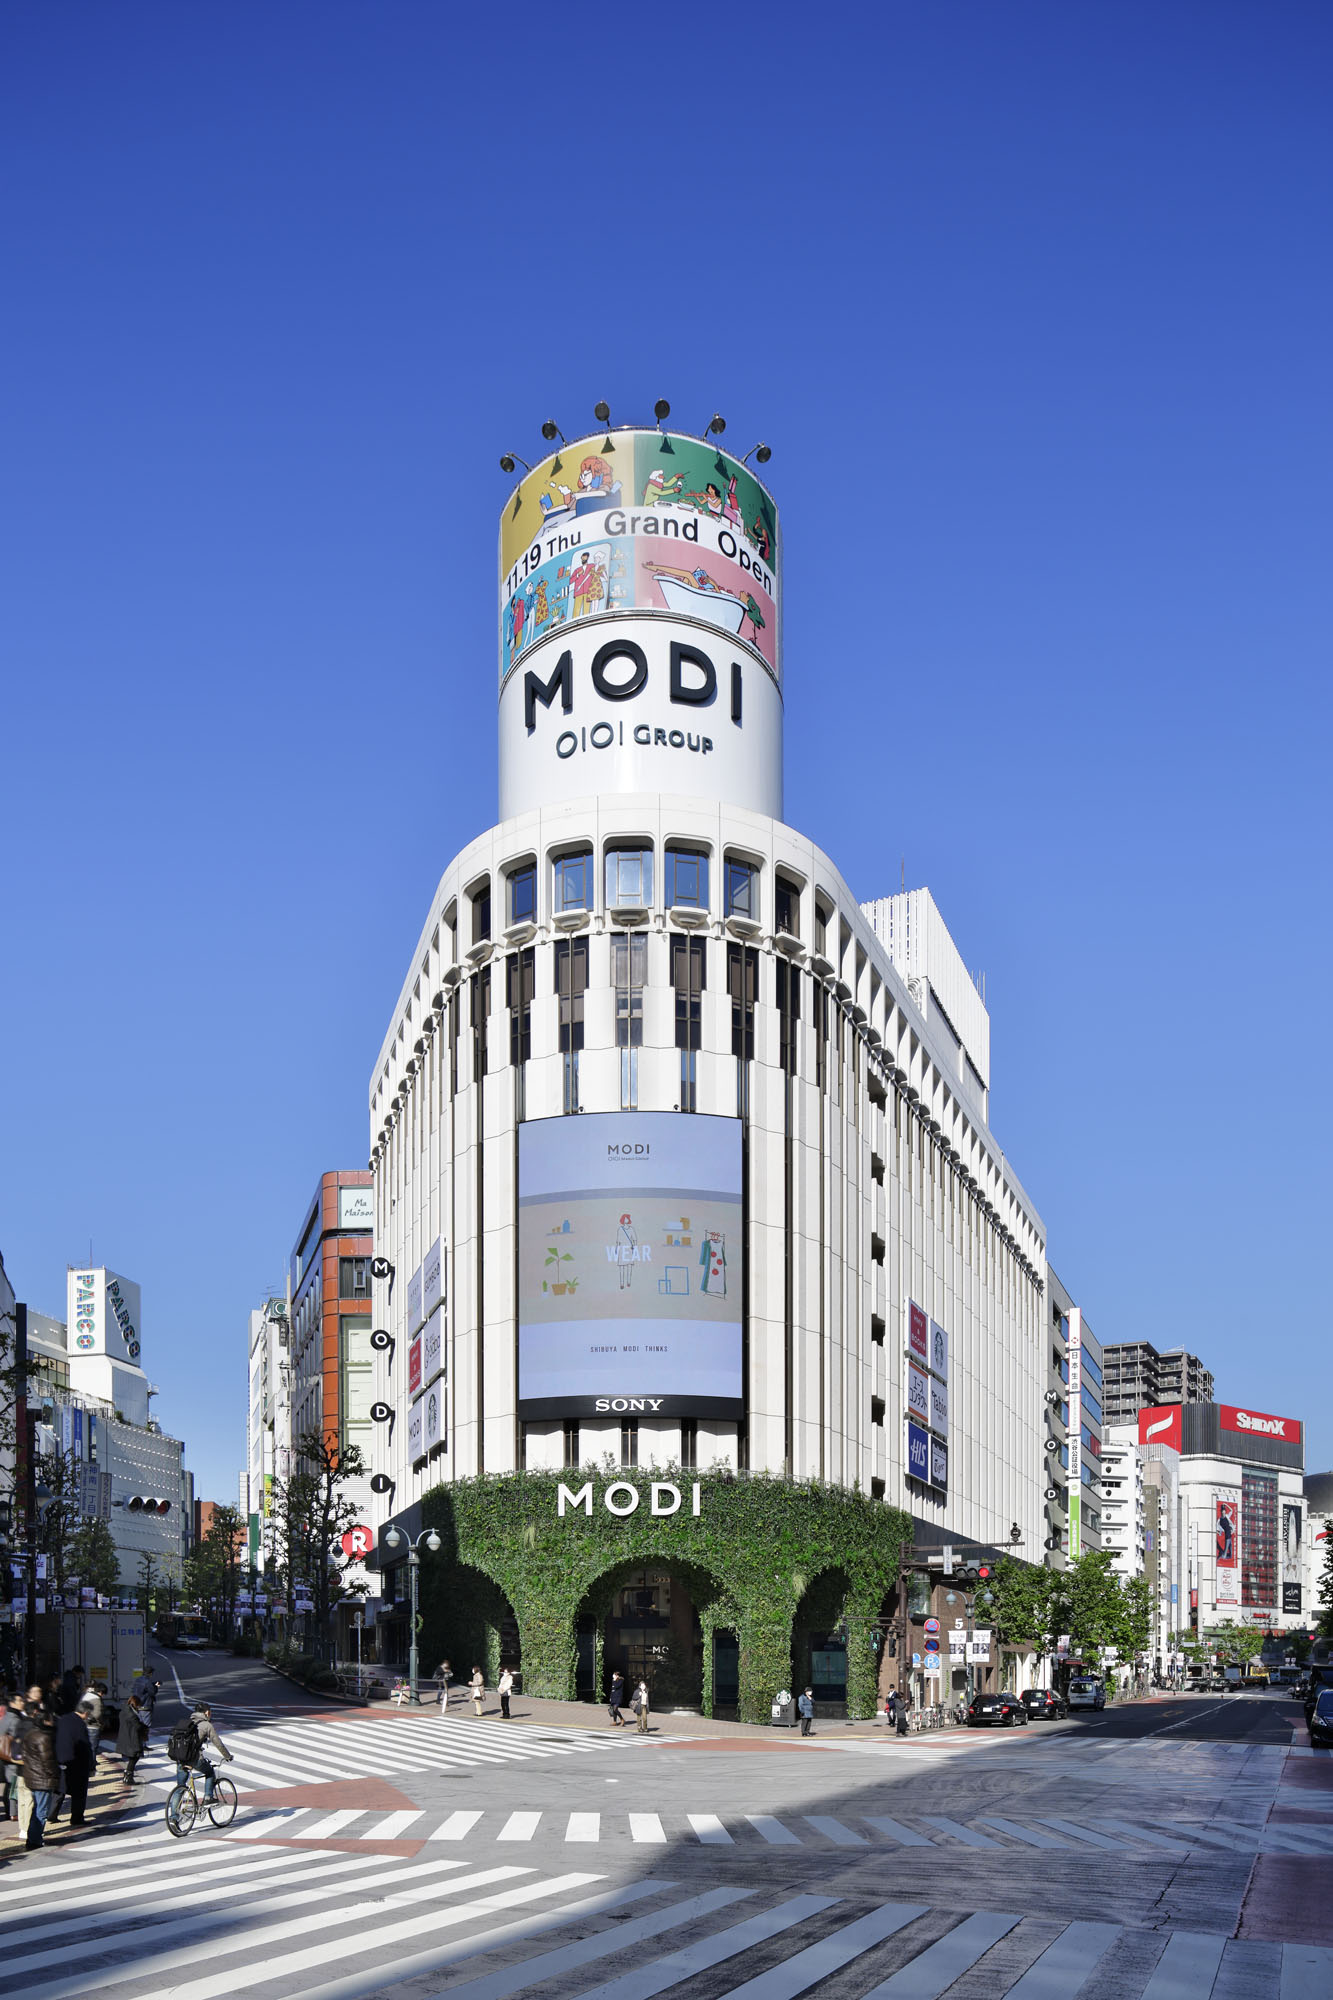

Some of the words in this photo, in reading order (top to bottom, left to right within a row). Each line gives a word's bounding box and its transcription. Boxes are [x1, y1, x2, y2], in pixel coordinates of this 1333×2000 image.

[547, 529, 582, 558] Thu
[604, 510, 699, 543] Grand
[717, 529, 773, 597] Open
[523, 638, 743, 730] MODI
[633, 723, 714, 755] GROUP
[607, 1143, 650, 1155] MODI
[354, 1198, 367, 1208] Ma
[605, 1244, 652, 1263] WEAR
[76, 1274, 96, 1350] PARCO
[106, 1279, 141, 1359] PARCO
[590, 1345, 618, 1353] SHIBUYA
[623, 1345, 640, 1353] MODI
[645, 1345, 668, 1353] THINKS
[595, 1398, 664, 1412] SONY
[931, 1389, 948, 1417] Tabio
[1236, 1411, 1286, 1437] SHIDAX
[88, 1465, 98, 1514] 神南一丁目
[557, 1481, 702, 1518] MODI
[352, 1531, 368, 1552] R
[53, 1594, 62, 1606] P
[954, 1618, 964, 1630] 5
